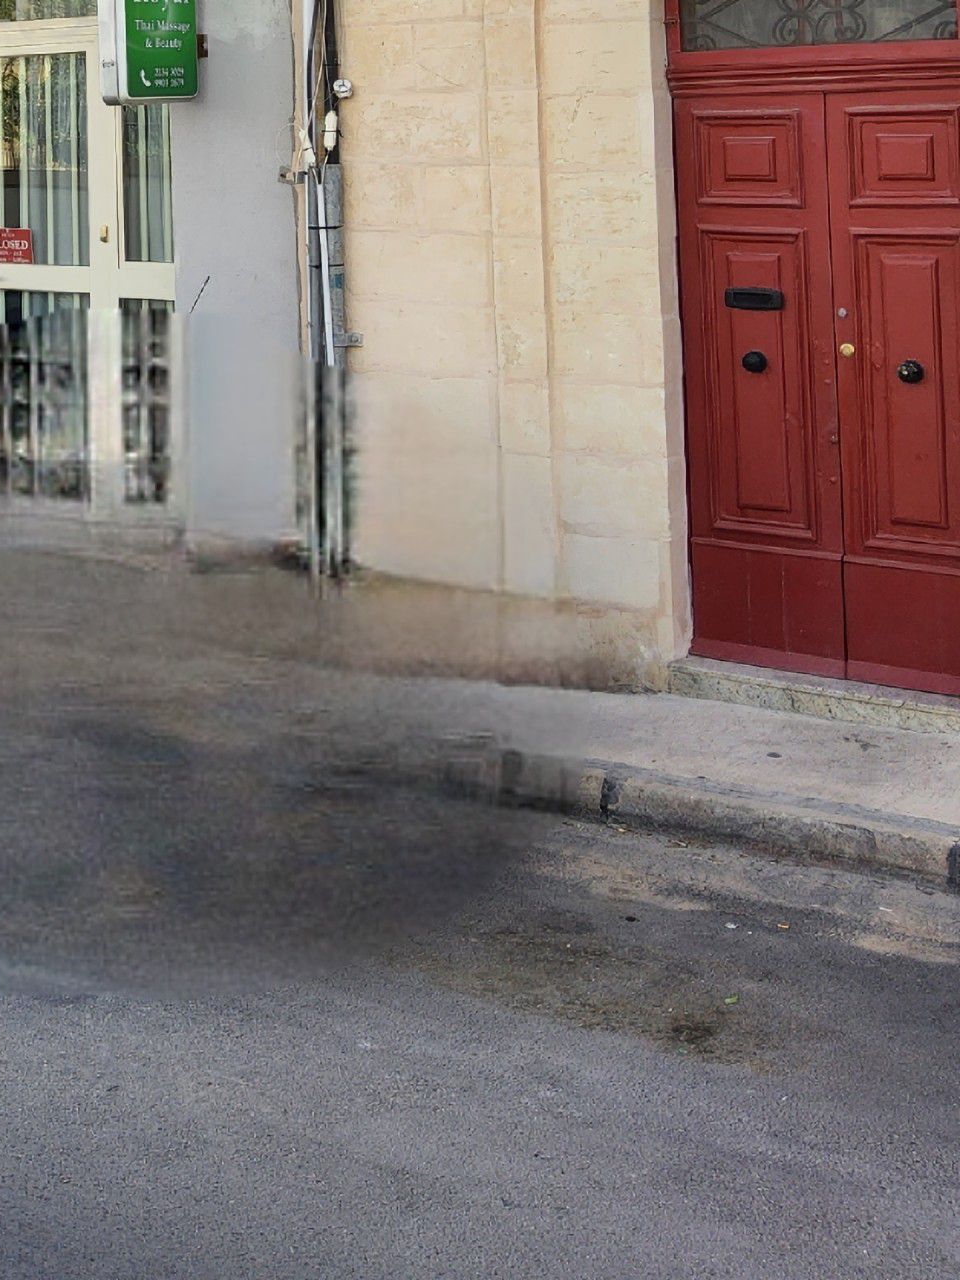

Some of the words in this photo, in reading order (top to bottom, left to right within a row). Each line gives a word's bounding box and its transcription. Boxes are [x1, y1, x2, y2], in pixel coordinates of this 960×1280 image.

[135, 19, 154, 31] Thai
[157, 20, 190, 34] Massage
[145, 38, 153, 49] &
[155, 37, 182, 51] Beauty
